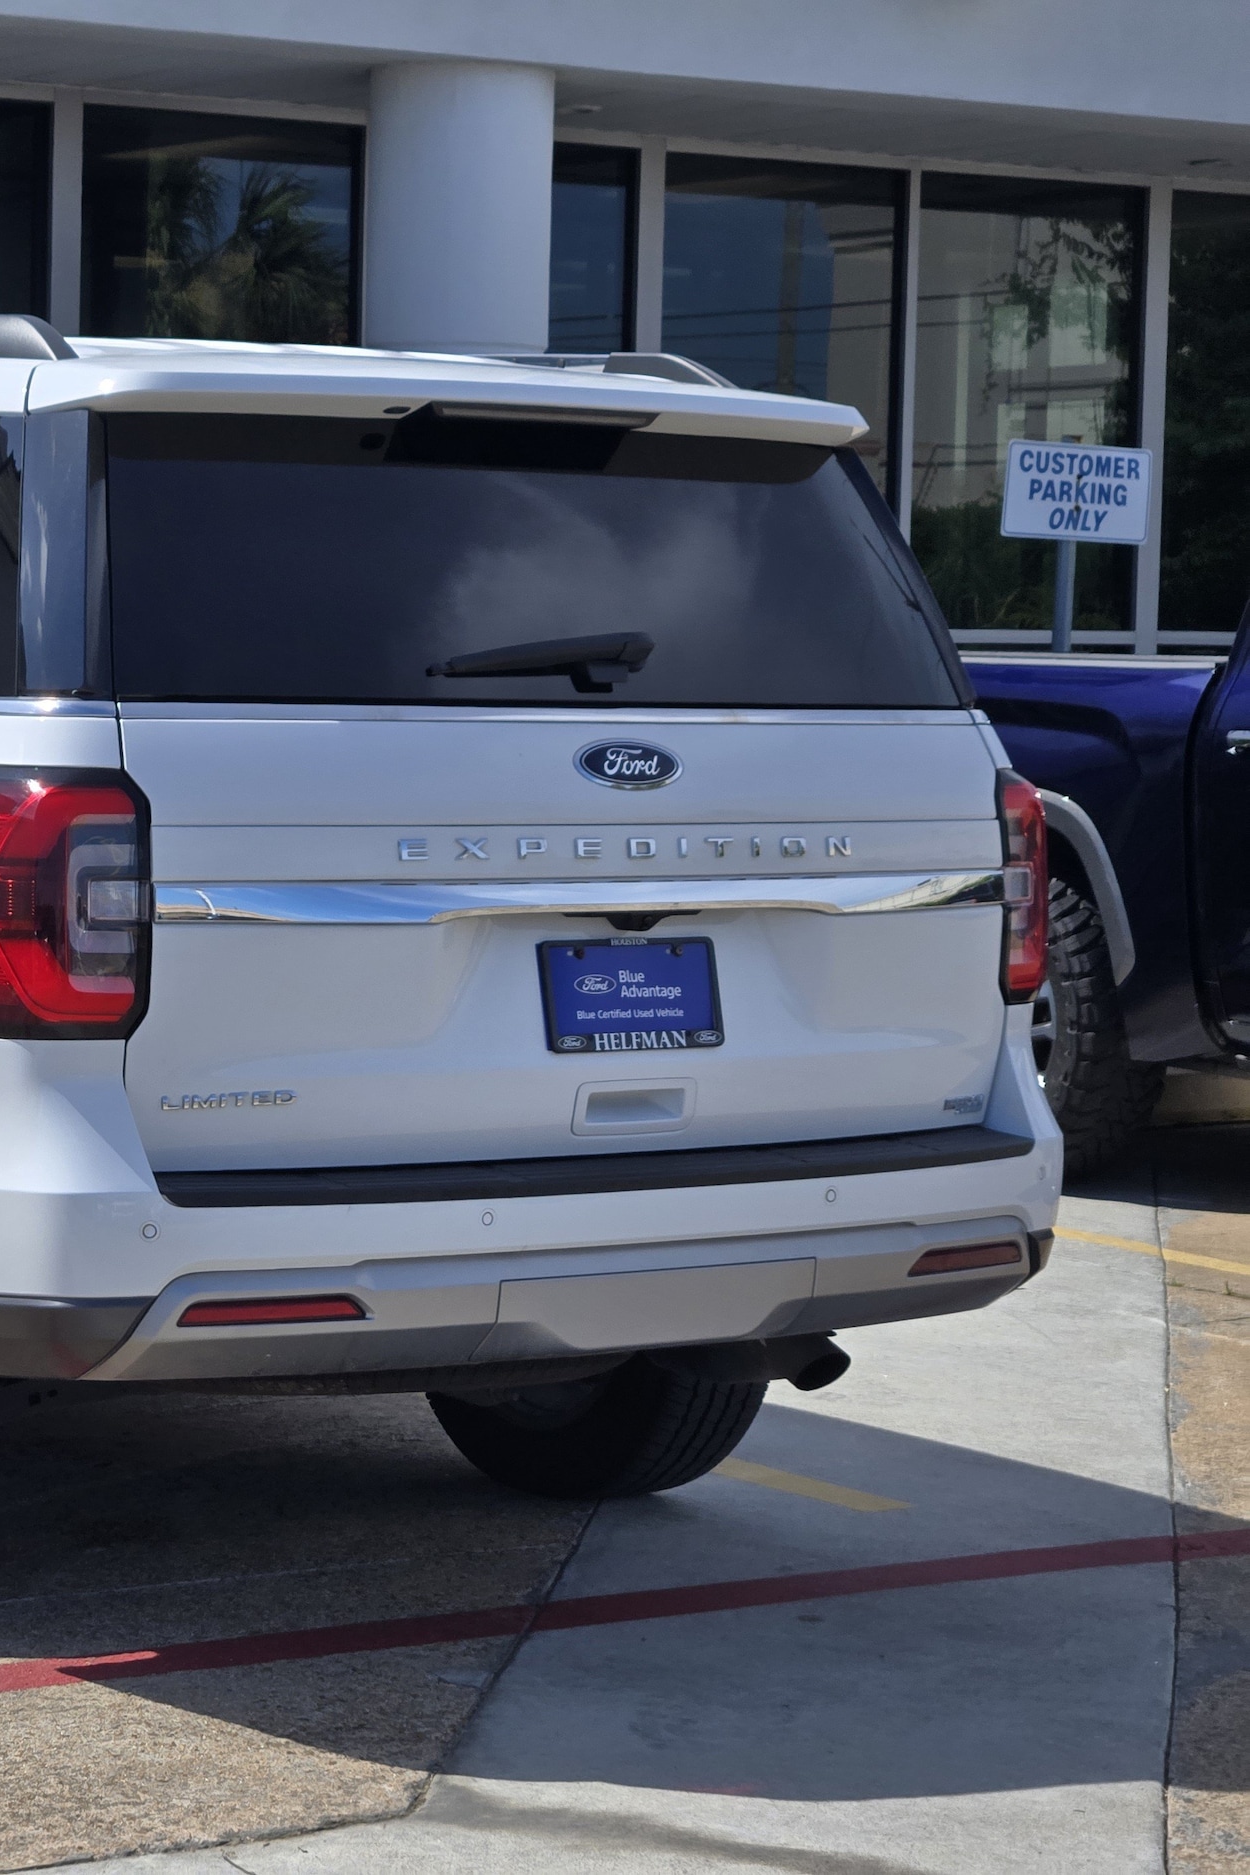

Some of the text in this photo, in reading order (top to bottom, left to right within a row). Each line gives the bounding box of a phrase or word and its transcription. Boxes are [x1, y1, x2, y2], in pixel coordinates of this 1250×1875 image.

[1019, 449, 1140, 480] CUSTOMER
[1028, 478, 1128, 507] PARKING
[1048, 507, 1109, 532] ONLY
[603, 747, 661, 778] Ford
[397, 835, 852, 862] EXPEDITION
[610, 938, 648, 947] HOUSTON
[582, 977, 609, 992] Ford
[618, 970, 645, 983] Blue
[621, 985, 682, 999] Advantage
[577, 1008, 684, 1020] Blue Certified Used Vehicle
[562, 1030, 718, 1051] Ford HELFMAN Ford
[161, 1089, 297, 1111] LIMITED
